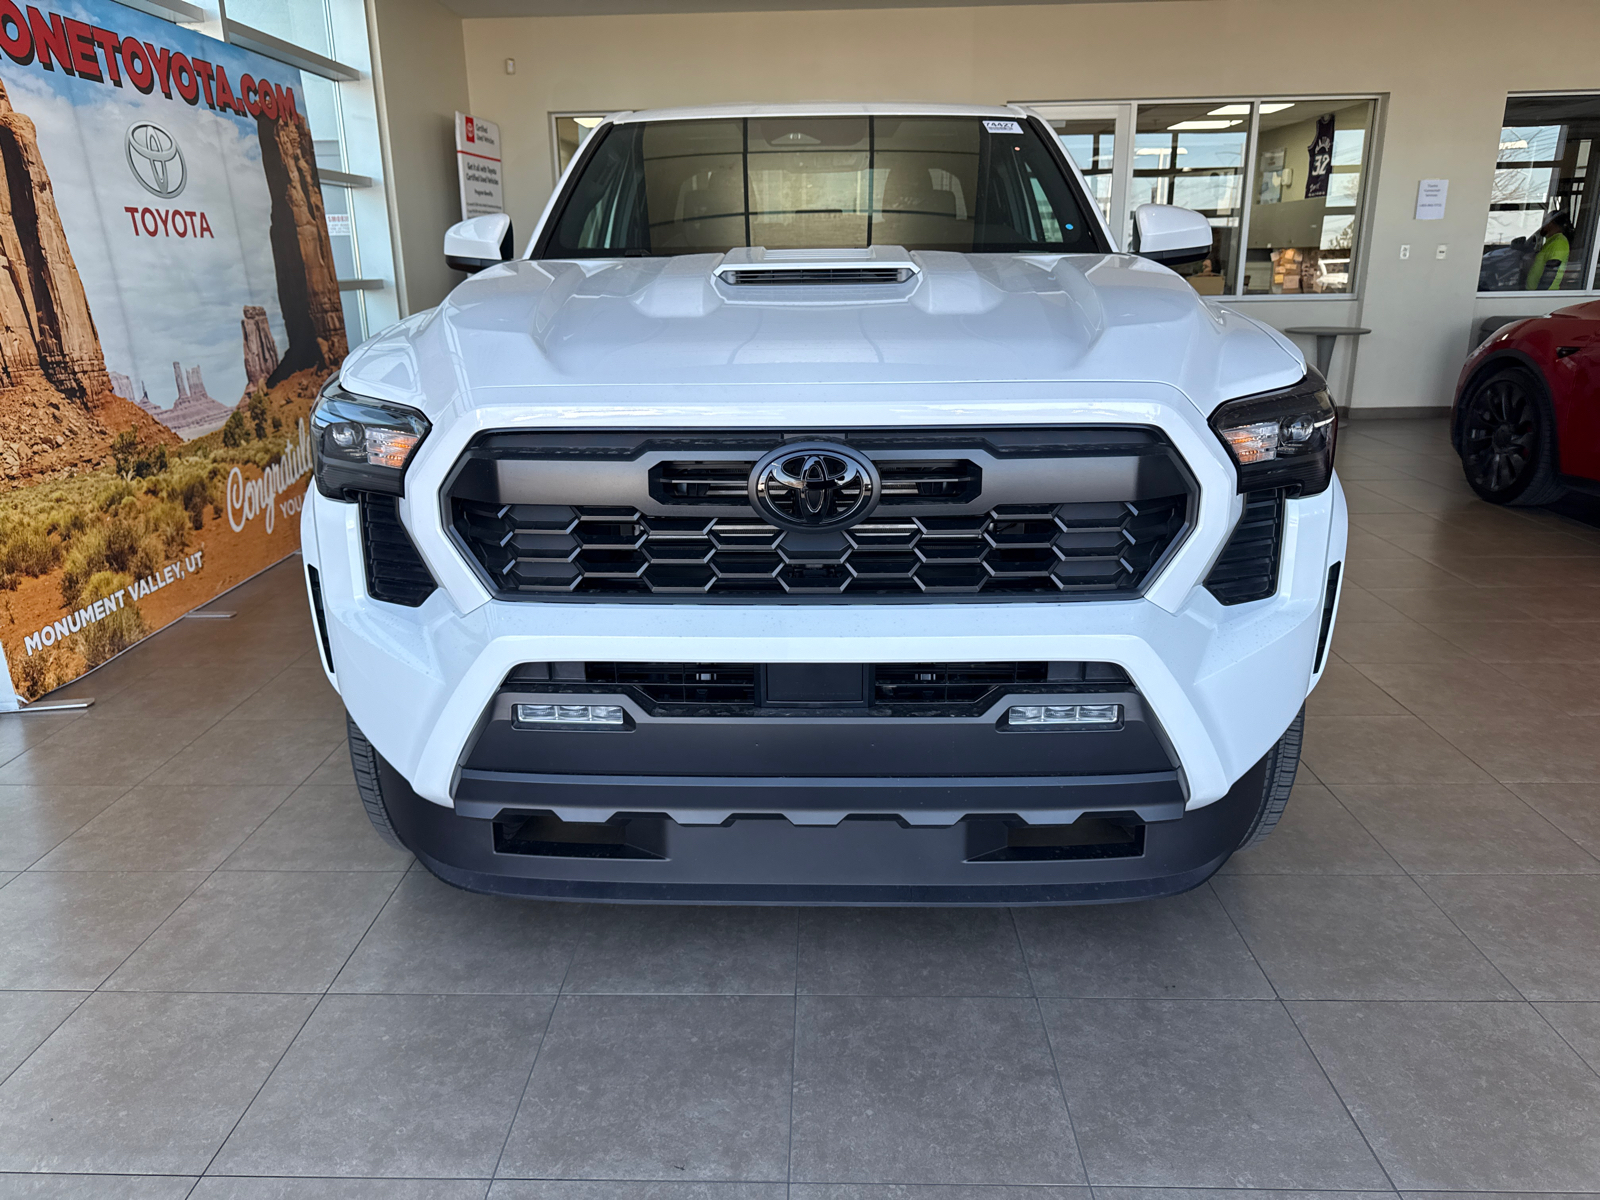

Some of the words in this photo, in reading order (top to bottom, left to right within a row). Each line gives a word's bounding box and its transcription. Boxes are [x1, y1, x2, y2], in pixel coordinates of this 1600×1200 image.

[1312, 154, 1330, 176] 32
[124, 206, 214, 239] TOYOTA
[23, 589, 125, 657] MONUMENT
[127, 561, 186, 602] VALLEY,
[185, 551, 203, 573] UT
